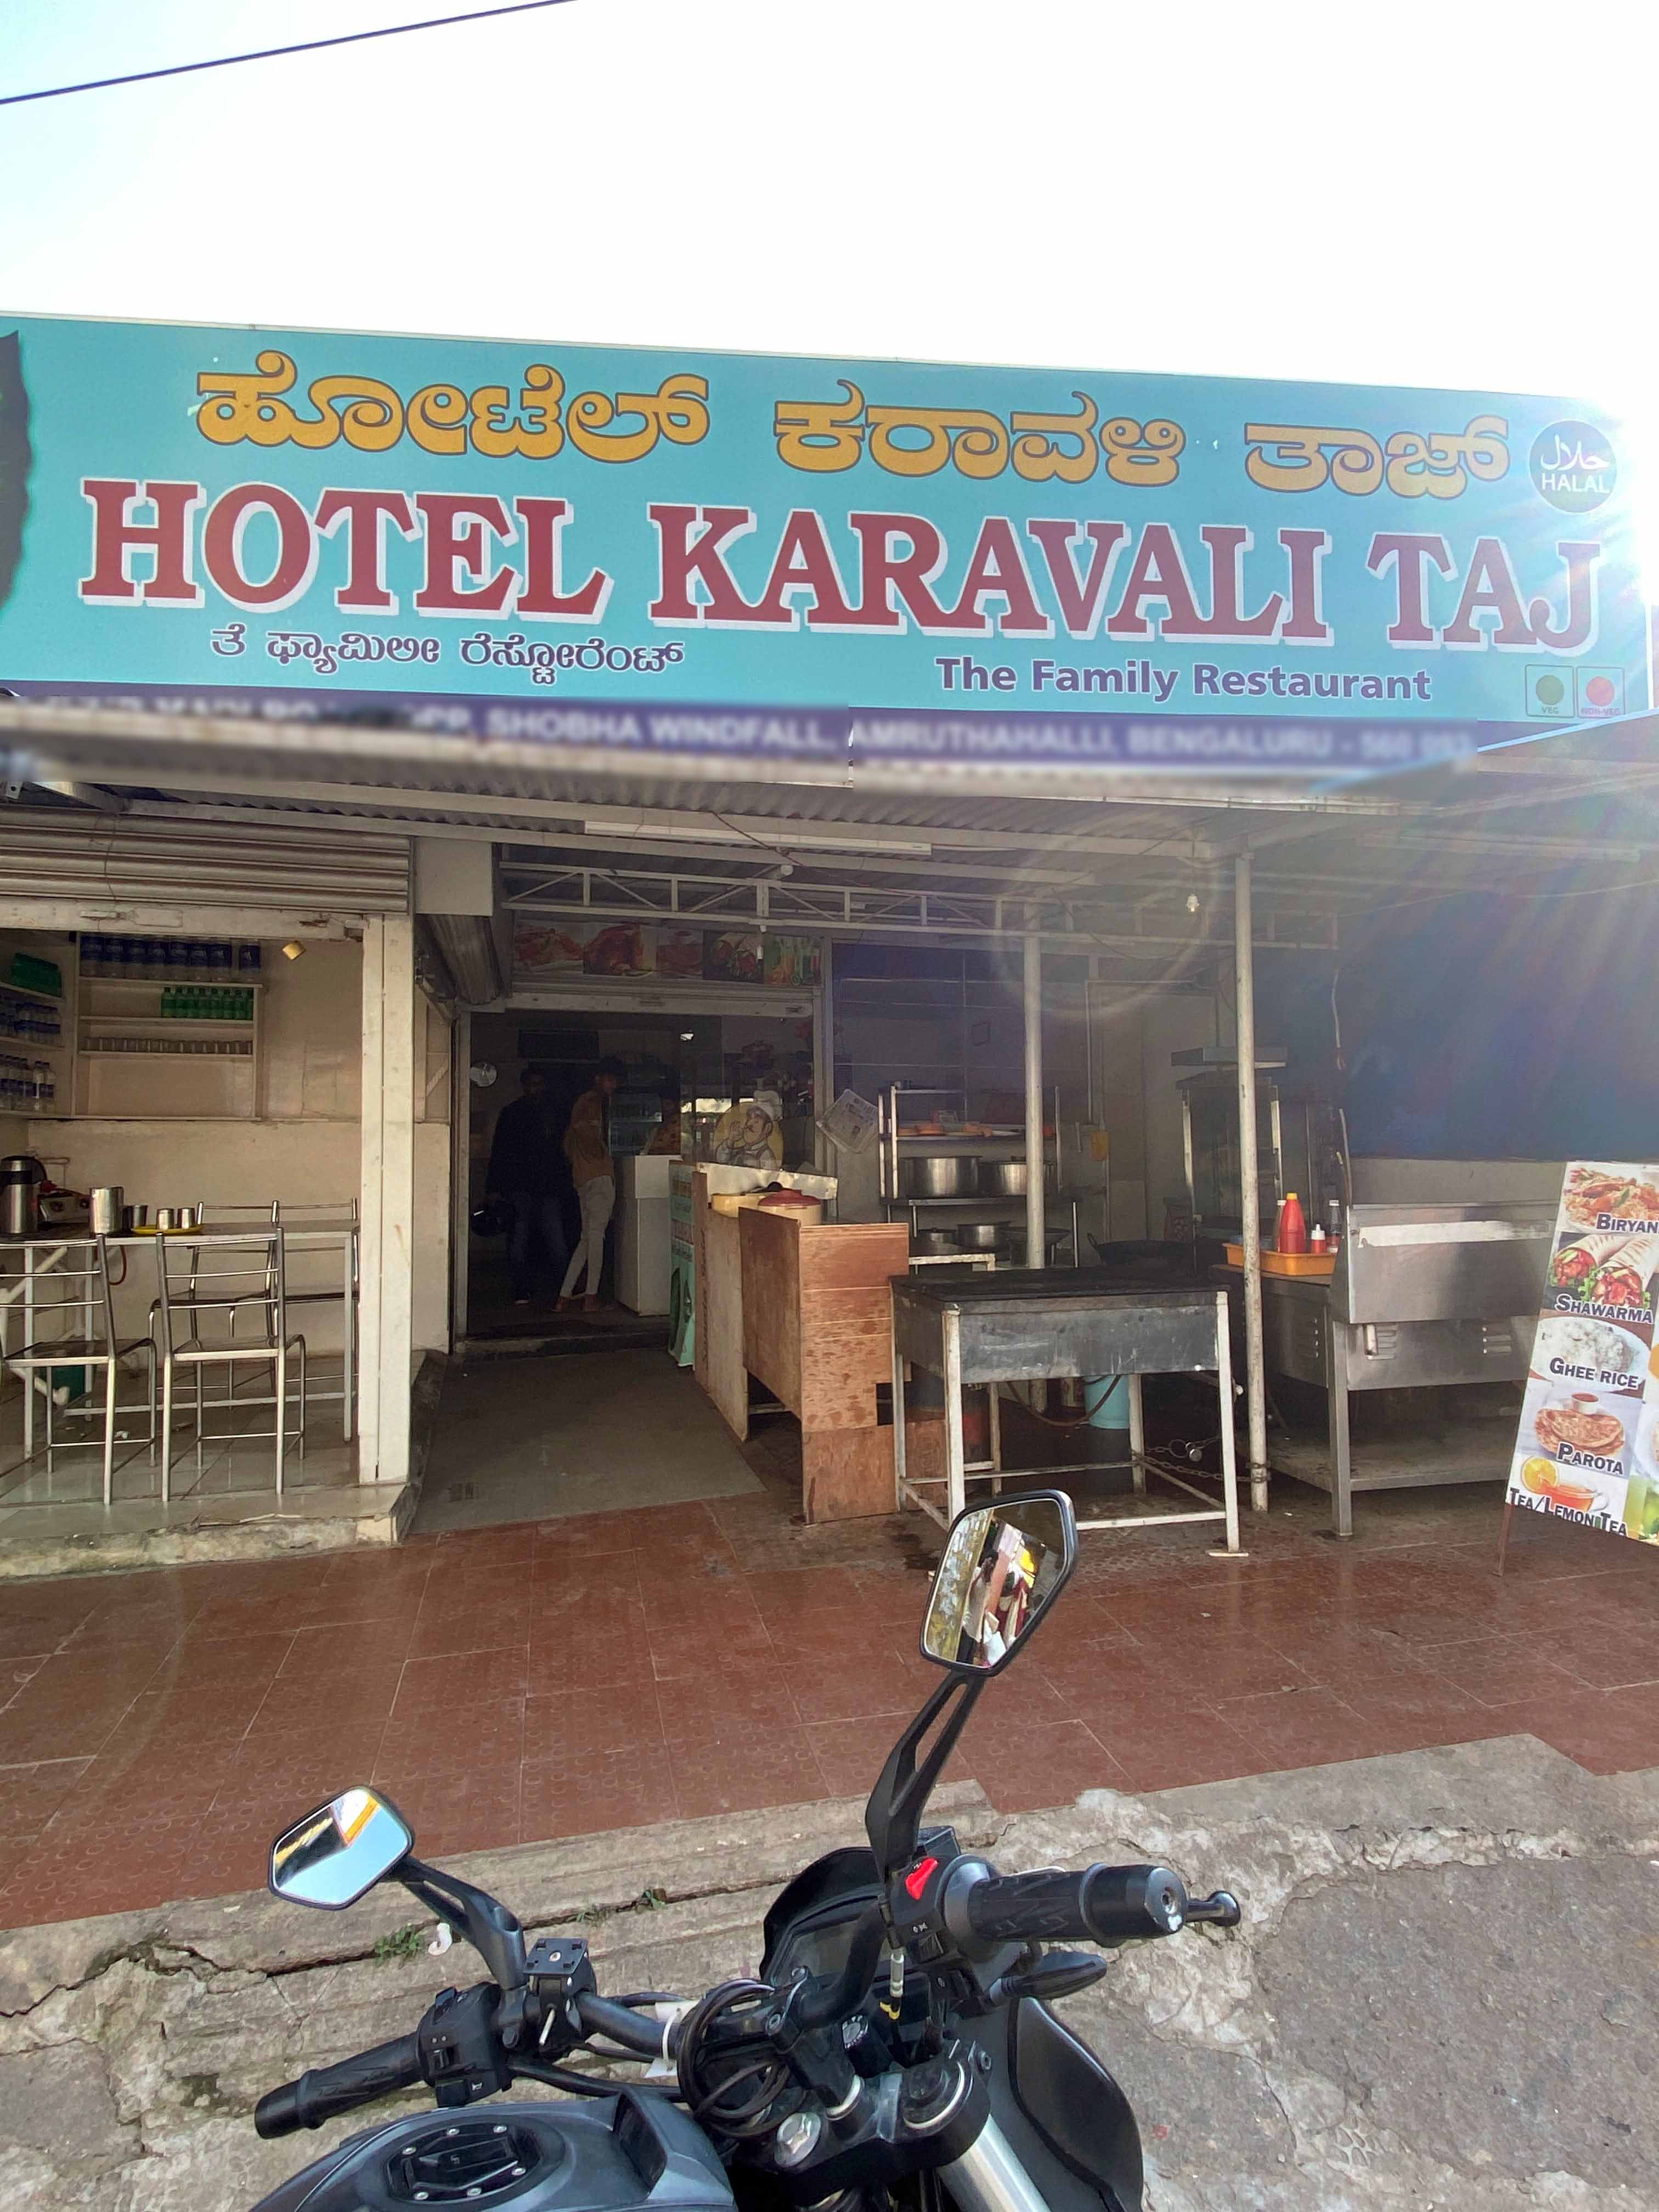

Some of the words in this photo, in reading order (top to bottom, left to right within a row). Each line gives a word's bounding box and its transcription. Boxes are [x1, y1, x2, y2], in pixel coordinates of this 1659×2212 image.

[196, 349, 709, 463] ಹೋಟೆಲ್
[774, 379, 1186, 487] ಕರಾವಳಿ
[1244, 415, 1509, 498] ತಾಜ್
[1541, 435, 1610, 471] حلال
[1542, 473, 1610, 493] HALAL
[78, 477, 614, 623] HOTEL
[647, 503, 1334, 648] KARAVALI
[1365, 532, 1601, 656] TAJ
[460, 632, 684, 685] ರೆಸ್ಟೋರೆಂಟ್
[935, 656, 1016, 691] The
[1032, 660, 1179, 702] Family
[1193, 663, 1432, 701] Restaurant
[1596, 1212, 1659, 1234] BIRYAN
[1556, 1294, 1653, 1324] SHAWARMA
[1550, 1357, 1595, 1381] GHEE
[1600, 1370, 1639, 1388] RICE
[1557, 1442, 1624, 1476] PAROTA
[1510, 1487, 1594, 1527] TEA/LEMON
[1600, 1511, 1628, 1537] TEA
